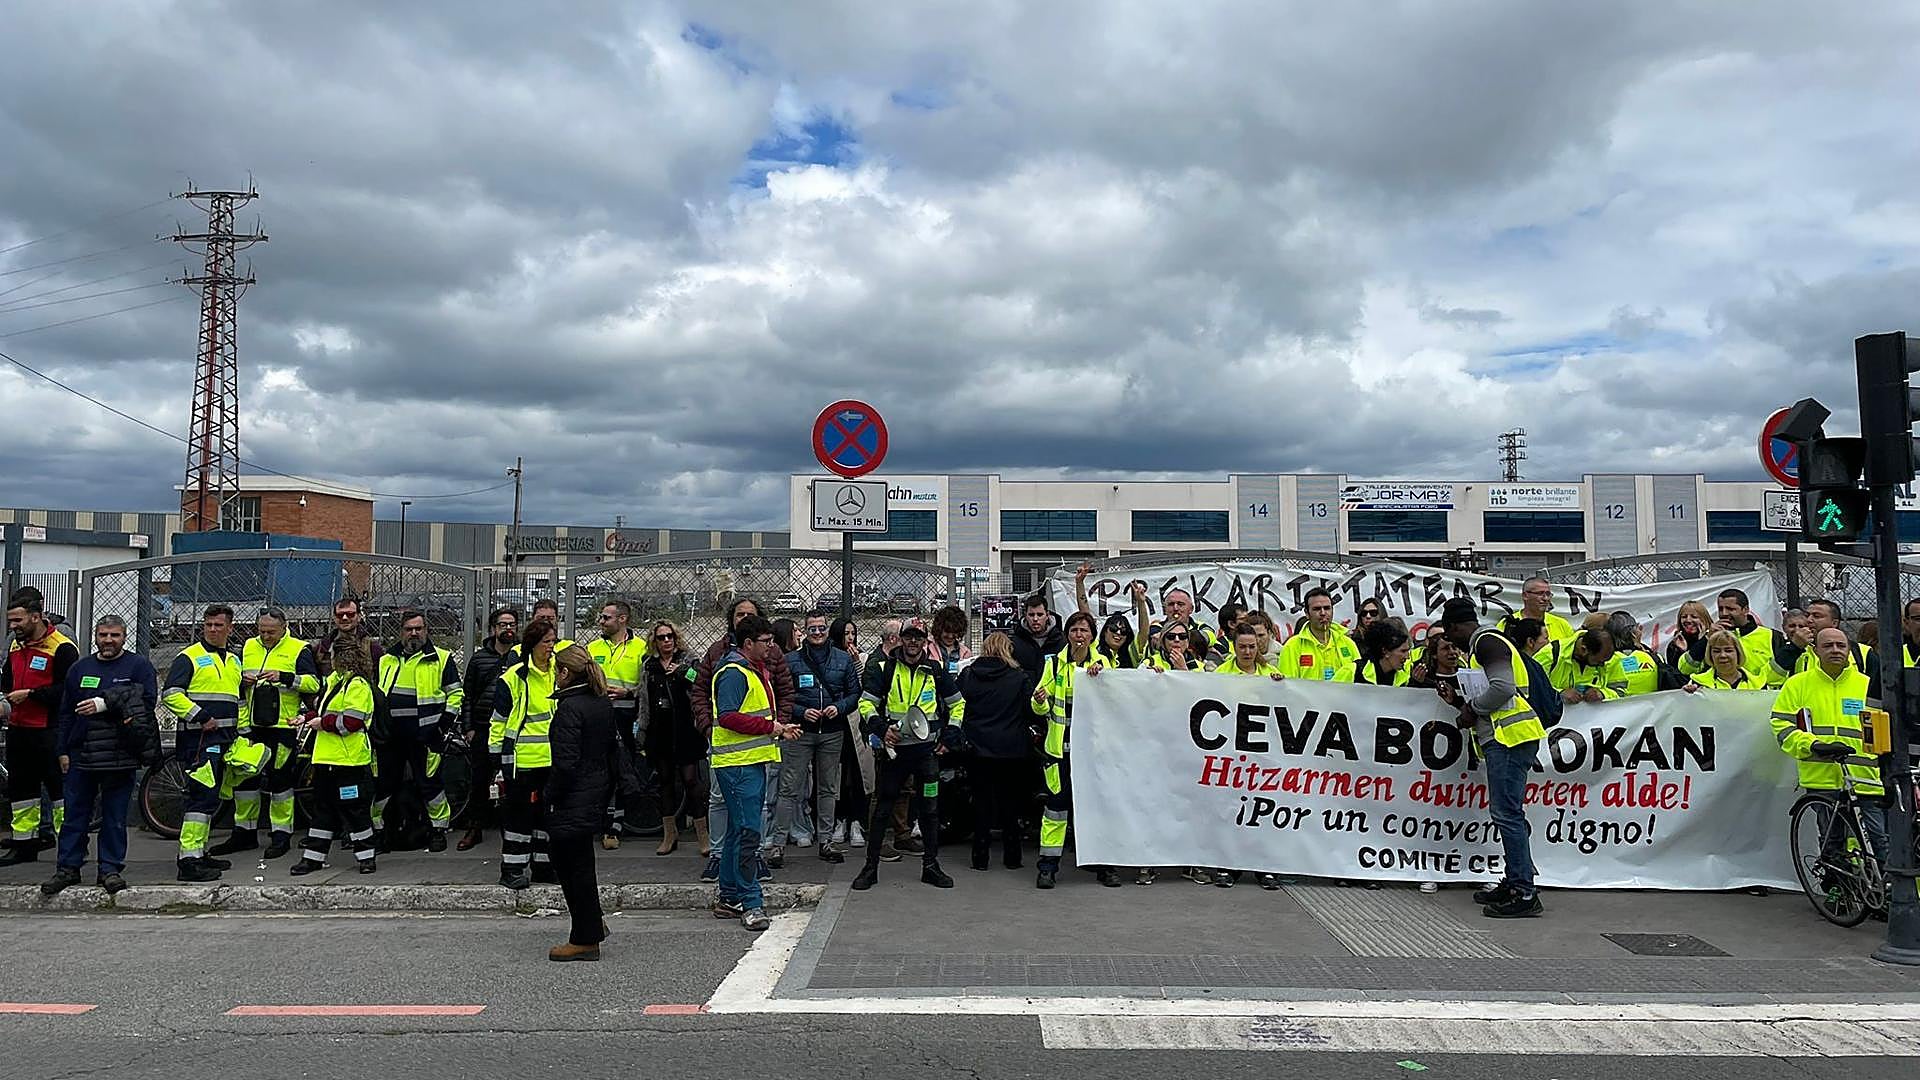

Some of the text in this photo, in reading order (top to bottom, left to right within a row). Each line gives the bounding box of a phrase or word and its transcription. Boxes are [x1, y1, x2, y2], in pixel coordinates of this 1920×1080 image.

[888, 486, 912, 500] ahn
[1545, 487, 1577, 495] brillante
[1780, 494, 1800, 503] EXCE
[1491, 495, 1508, 505] nb
[959, 503, 978, 517] 15
[1249, 503, 1268, 518] 14
[1309, 503, 1327, 518] 13
[1605, 504, 1624, 519] 12
[1668, 504, 1685, 519] 11
[816, 517, 884, 527] T. Max. 15 Min.
[1779, 518, 1801, 527] IZAN-
[1088, 569, 1602, 617] PRKARIETATEARN
[987, 606, 1013, 614] BARRIO
[1189, 698, 1716, 773] CEVA BOOKAN
[1198, 754, 1691, 810] Hitzarmen duin aten alde!
[1235, 795, 1657, 855] ¡Por un conven digno!
[1357, 847, 1462, 875] COMITÉ
